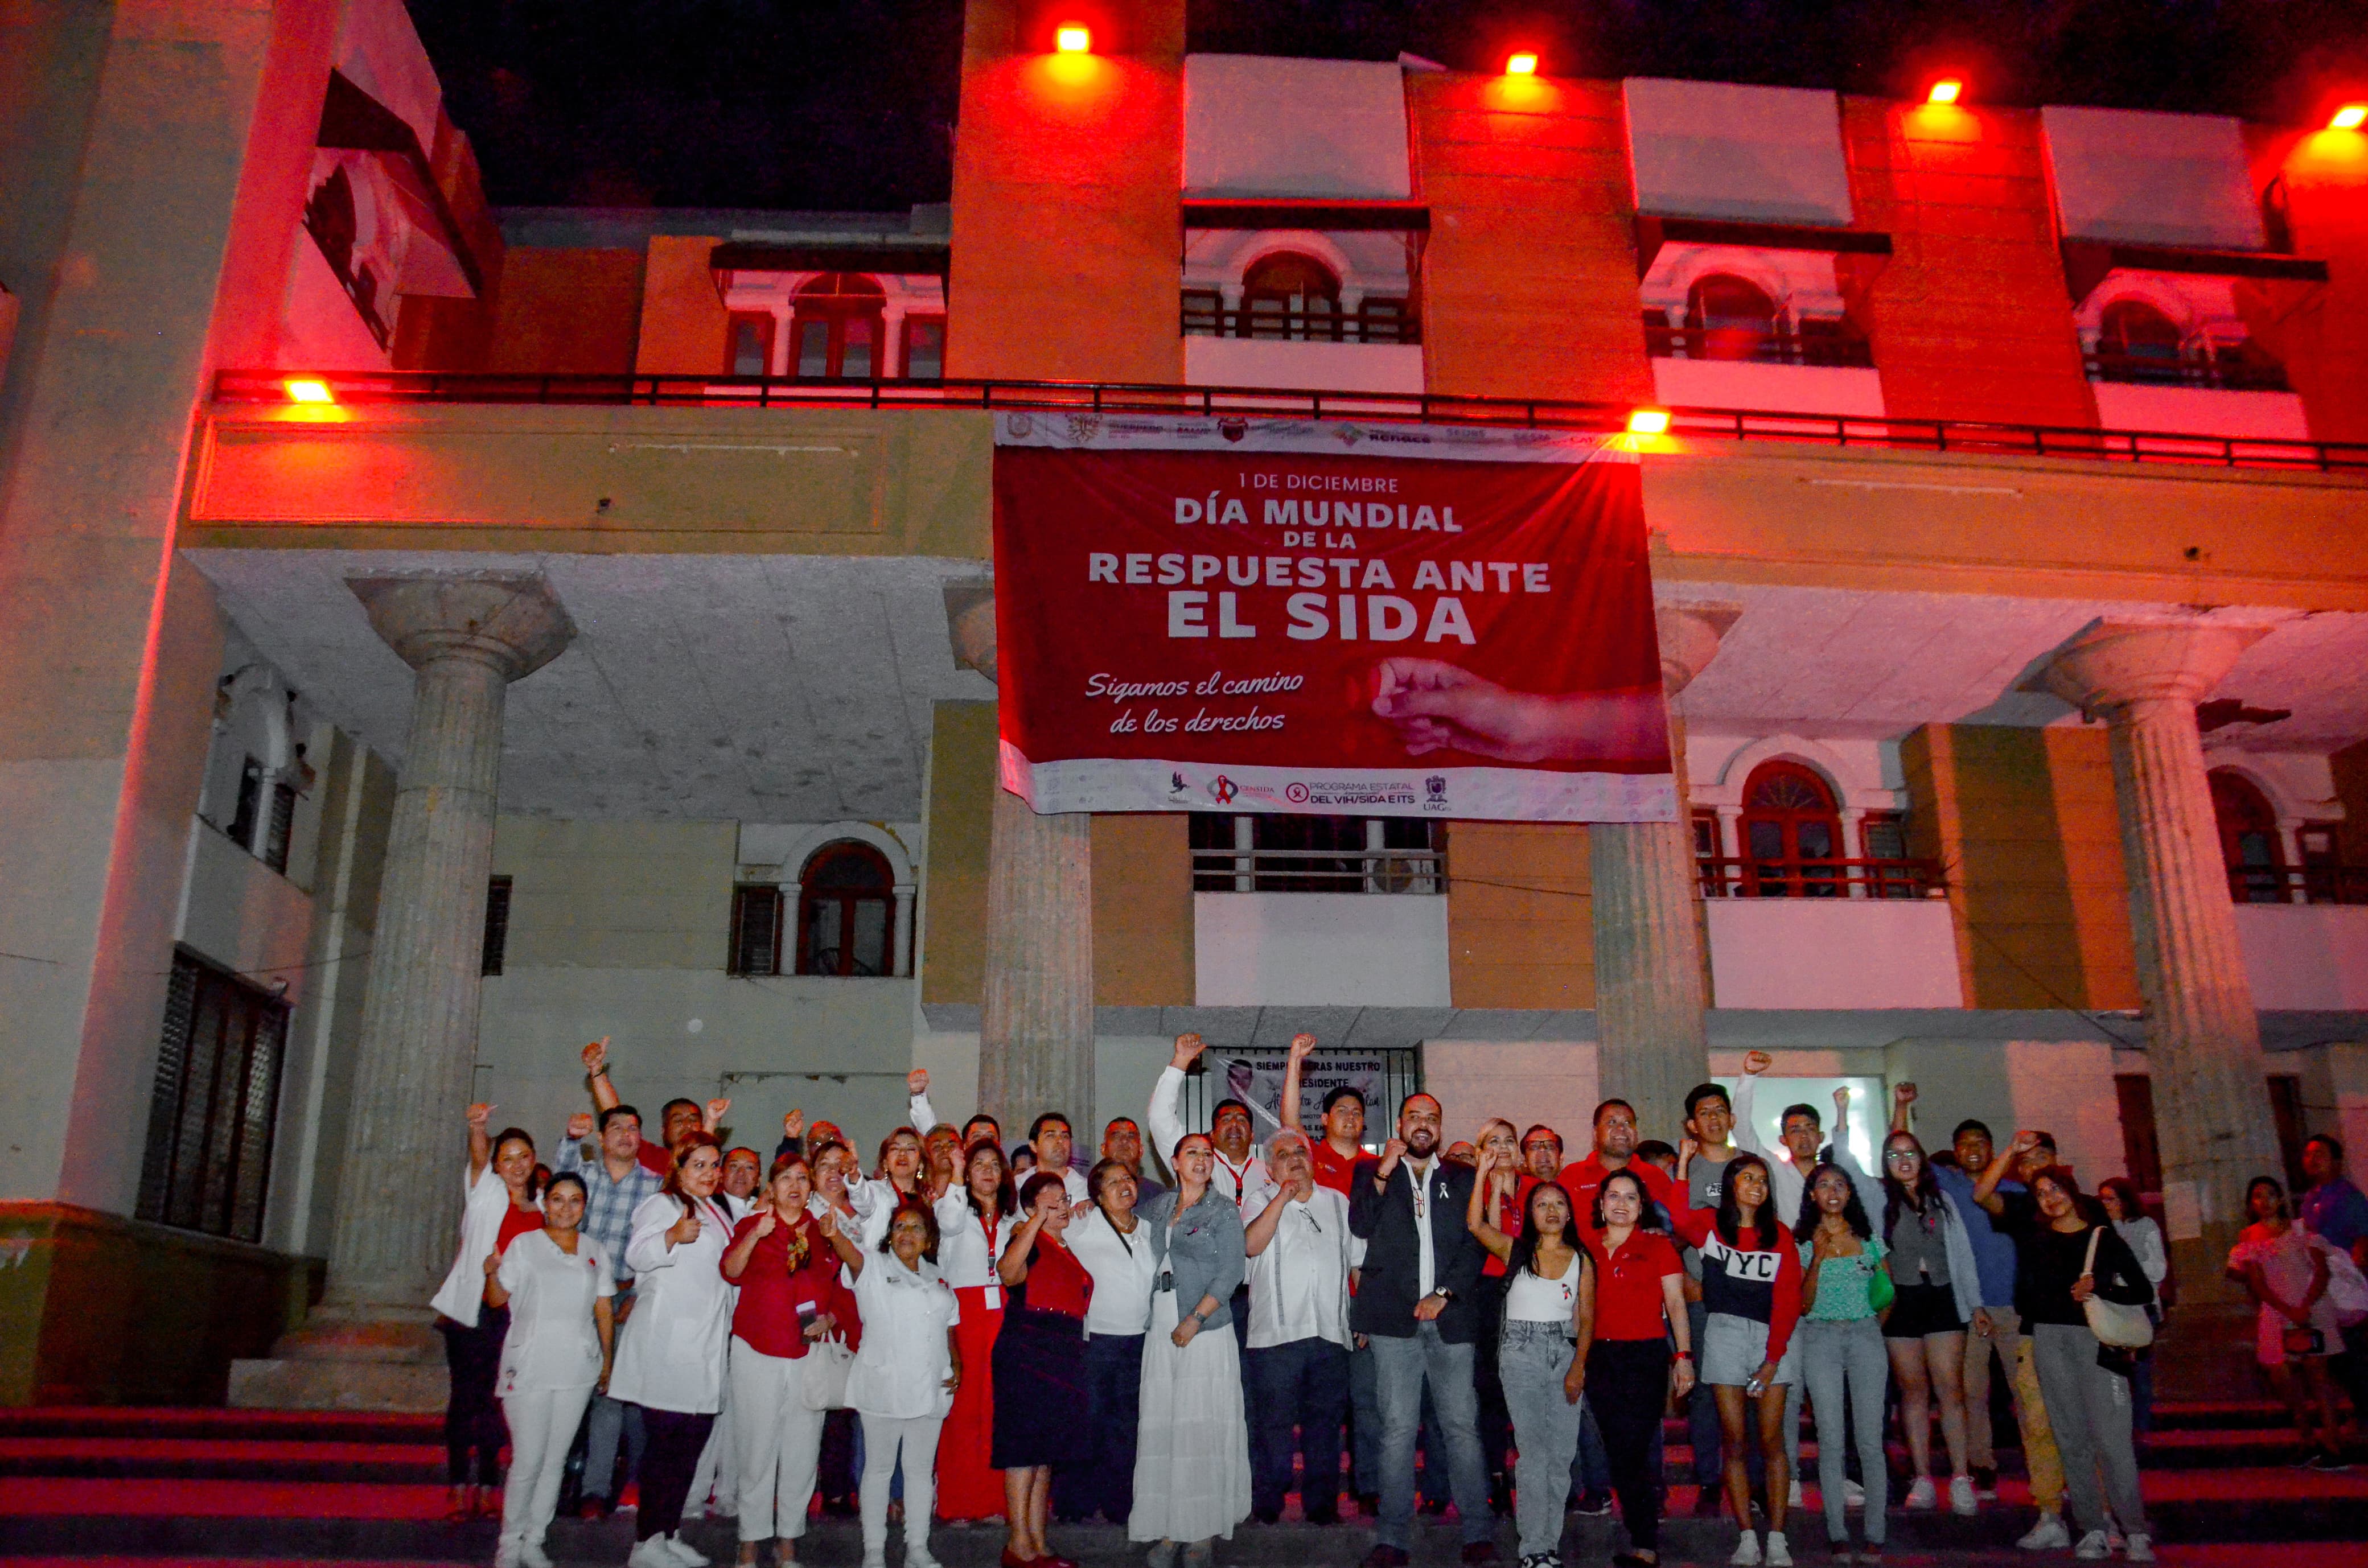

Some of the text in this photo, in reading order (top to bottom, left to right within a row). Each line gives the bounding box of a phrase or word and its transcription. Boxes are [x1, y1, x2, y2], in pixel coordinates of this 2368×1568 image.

[1240, 473, 1398, 493] 1 DE DICIEMBRE
[1175, 490, 1462, 532] DÍA MUNDIAL
[1284, 531, 1356, 549] DE LA
[1089, 553, 1551, 593] RESPUESTA ANTE
[1168, 590, 1477, 645] EL SIDA
[1085, 671, 1304, 703] Sigamos el camino
[1109, 705, 1285, 733] de los derechos
[1310, 782, 1367, 791] PROGRAMA
[1310, 795, 1333, 804] DEL
[1334, 795, 1386, 804] VIH/SIDA
[1397, 795, 1415, 804] ITS
[1256, 1061, 1288, 1071] SIEMP
[1335, 1061, 1380, 1071] NUESTRO
[1298, 1078, 1349, 1088] ESIDENTE
